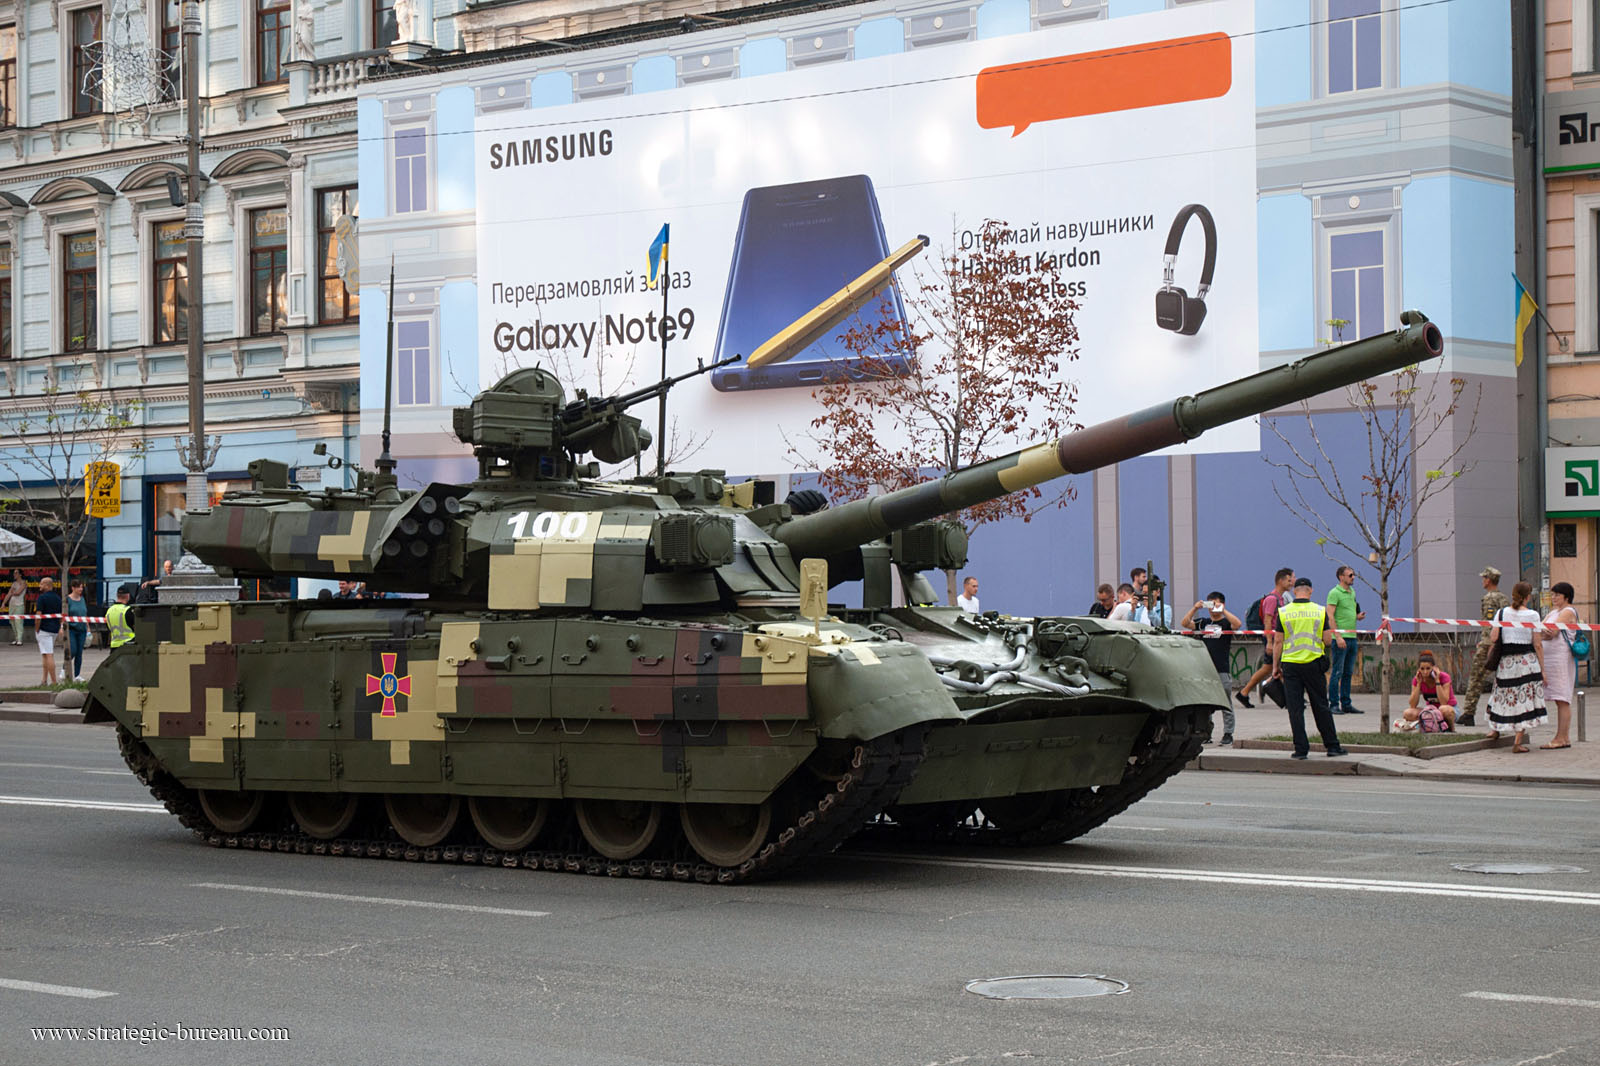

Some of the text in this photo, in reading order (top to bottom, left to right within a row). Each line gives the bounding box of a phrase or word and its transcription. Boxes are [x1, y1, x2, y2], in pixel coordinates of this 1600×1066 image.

[490, 129, 613, 170] SAMSUNG
[1046, 214, 1155, 243] навушники
[1035, 246, 1101, 271] Kardon
[492, 269, 635, 308] Передзамовляй
[494, 307, 695, 358] Galaxy Note9
[507, 511, 588, 539] 100
